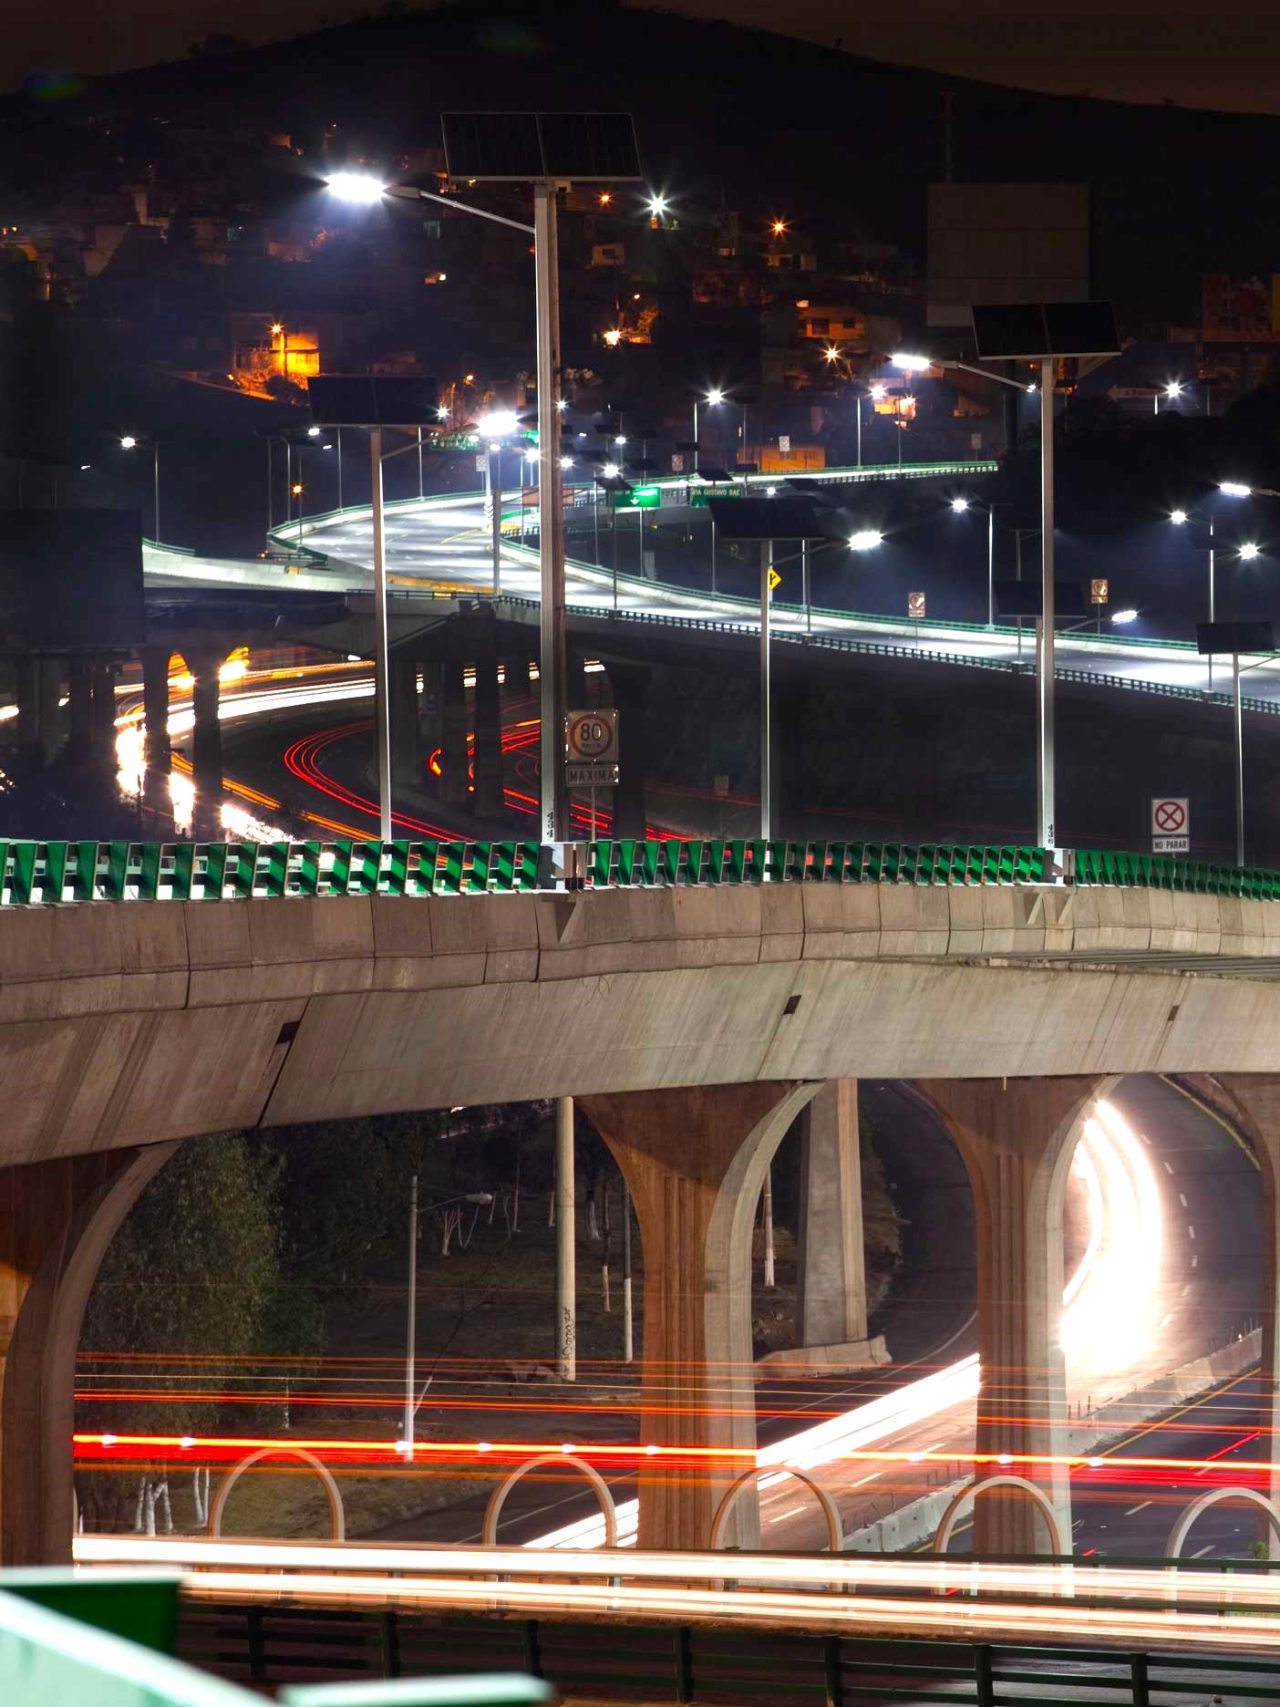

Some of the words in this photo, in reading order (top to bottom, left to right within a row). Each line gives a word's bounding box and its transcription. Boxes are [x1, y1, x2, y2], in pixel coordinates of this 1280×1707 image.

[580, 723, 602, 741] 80
[569, 768, 614, 781] MAXIMA
[1154, 840, 1164, 850] NO
[1166, 840, 1187, 850] PARAR
